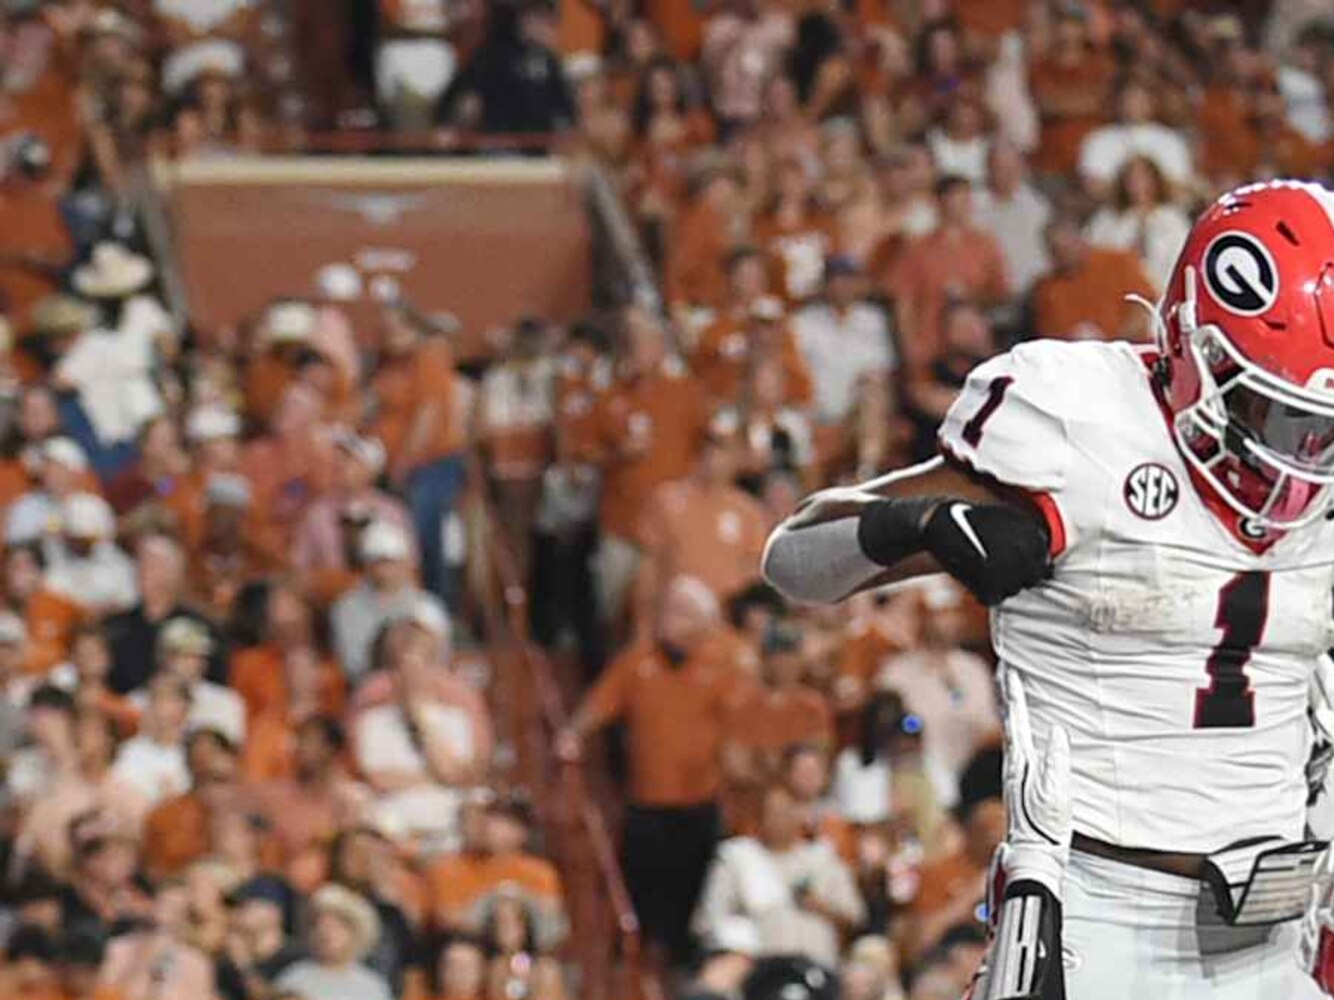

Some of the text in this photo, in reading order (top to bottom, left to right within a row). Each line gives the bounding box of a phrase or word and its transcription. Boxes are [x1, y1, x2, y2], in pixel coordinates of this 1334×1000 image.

[1204, 231, 1279, 315] G
[961, 376, 1016, 451] 1
[1128, 464, 1176, 517] SEC
[1193, 570, 1272, 729] 1
